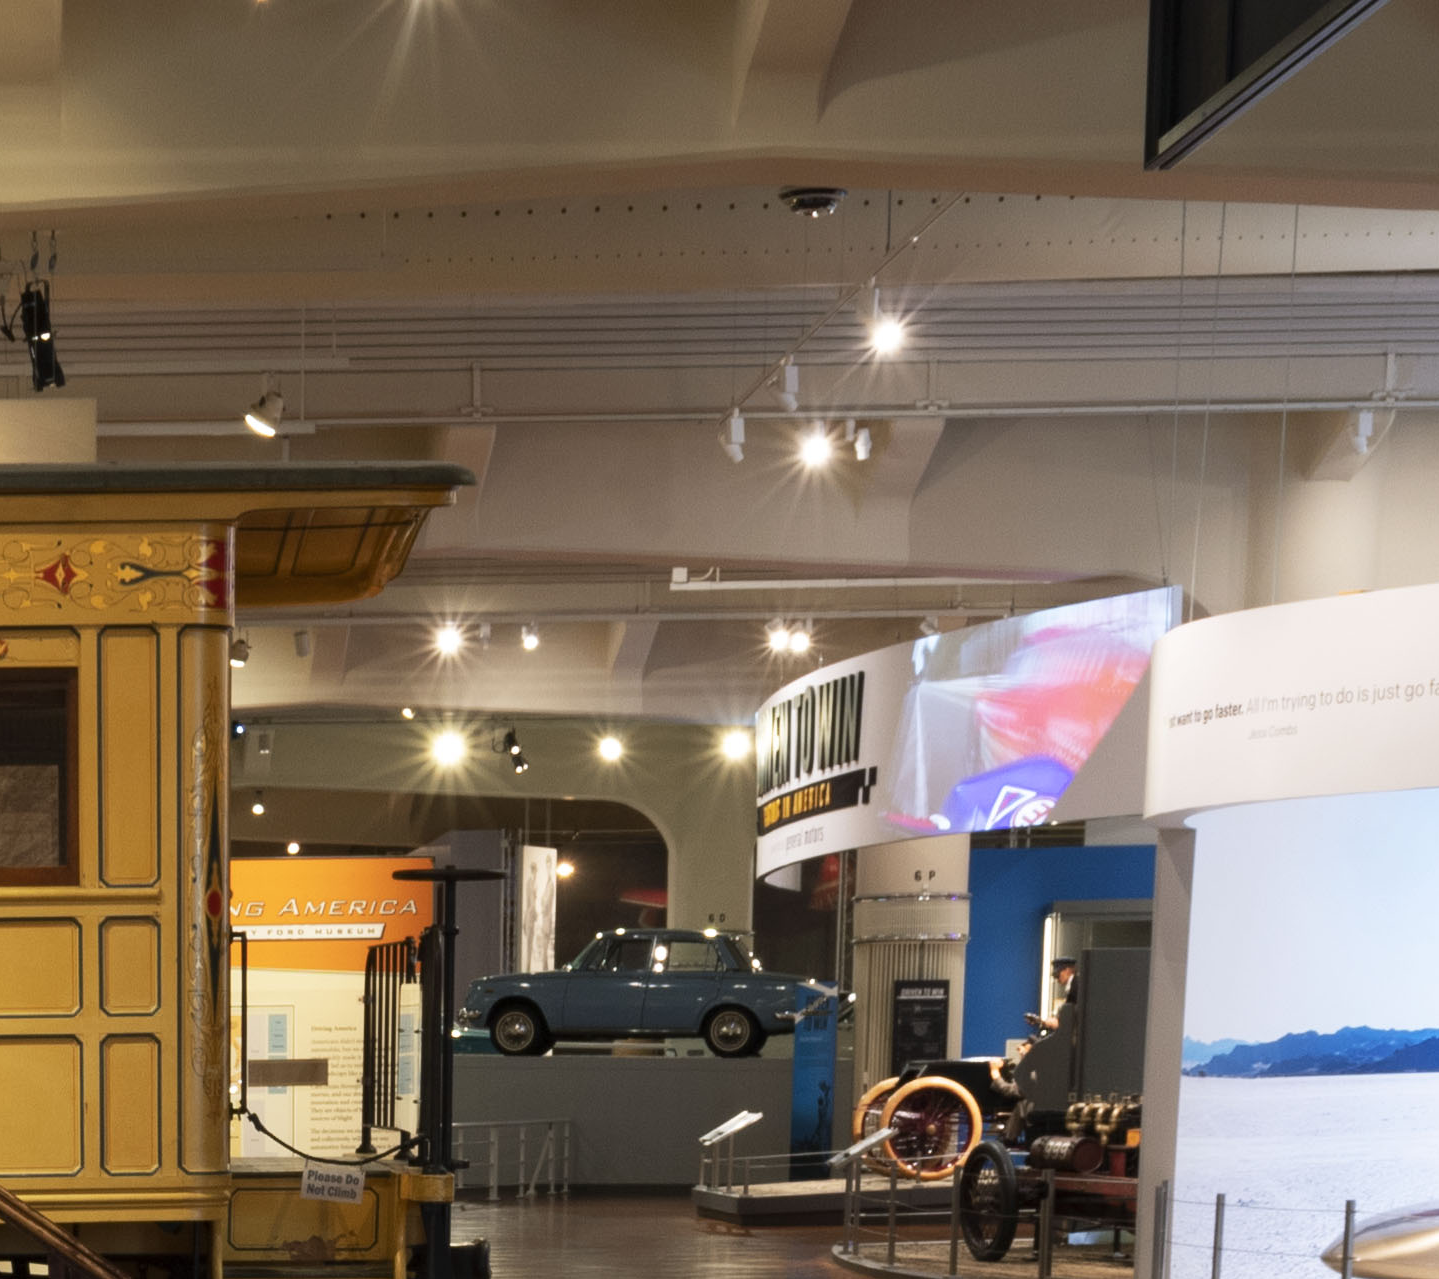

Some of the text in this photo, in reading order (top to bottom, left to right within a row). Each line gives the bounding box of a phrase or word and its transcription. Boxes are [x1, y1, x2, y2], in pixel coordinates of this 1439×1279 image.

[1203, 708, 1213, 724] go
[1214, 703, 1243, 719] faster.
[1282, 693, 1316, 713] trying
[1320, 690, 1333, 706] to
[1336, 687, 1354, 704] do
[1357, 686, 1369, 702] is
[1372, 683, 1400, 704] just
[1404, 683, 1425, 703] go
[818, 671, 866, 772] WIN
[278, 898, 417, 917] AMERICA
[315, 928, 376, 936] MUSEUM
[307, 1169, 360, 1185] Please Do
[307, 1183, 357, 1199] Not Climb
